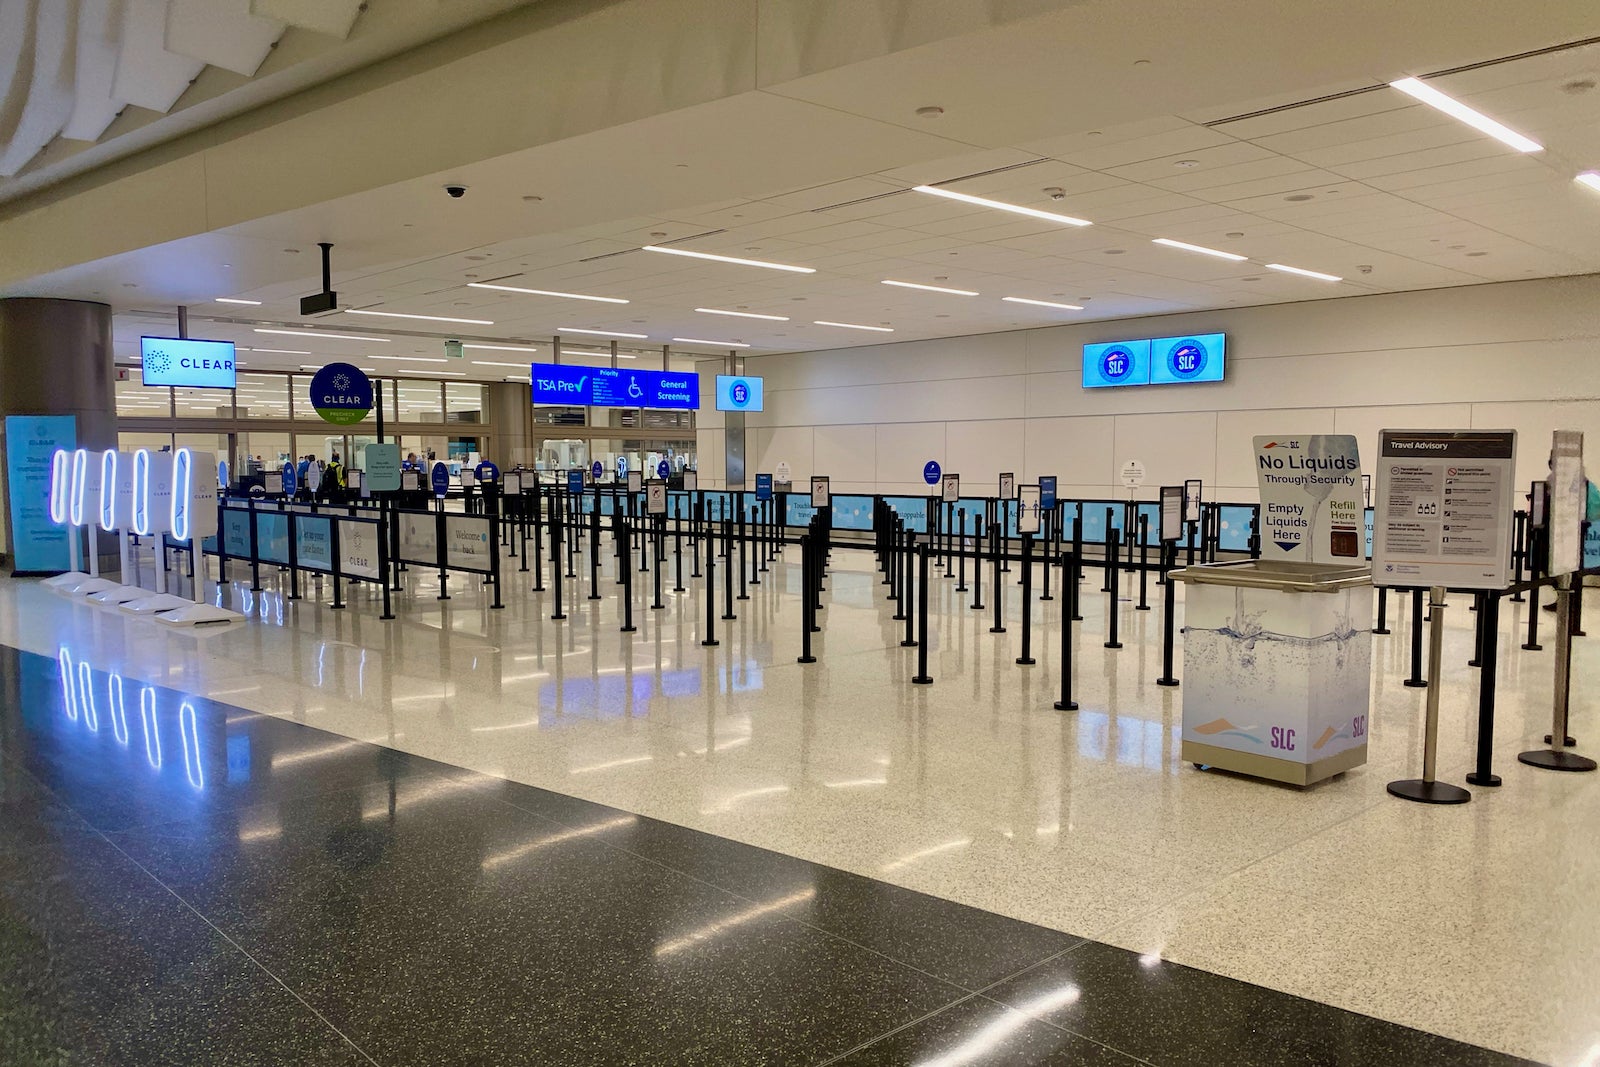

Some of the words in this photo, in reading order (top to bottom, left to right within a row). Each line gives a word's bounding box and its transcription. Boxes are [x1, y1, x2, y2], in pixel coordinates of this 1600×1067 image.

[180, 358, 232, 370] CLEAR
[1108, 360, 1123, 374] SLC
[1179, 355, 1194, 370] SLC
[537, 380, 556, 391] TSA
[558, 381, 574, 392] Pre
[660, 380, 687, 389] General
[324, 396, 360, 404] CLEAR
[658, 392, 690, 402] Screening
[1259, 455, 1284, 469] No
[1289, 455, 1357, 472] Liquids
[1265, 474, 1307, 485] Through
[1310, 475, 1355, 486] Security
[1268, 503, 1304, 515] Empty
[1330, 501, 1356, 510] Refill
[1331, 511, 1356, 520] Here
[1266, 516, 1307, 528] Liquids
[456, 530, 480, 541] Welcome
[1273, 530, 1300, 540] Here
[462, 546, 475, 554] back
[350, 556, 368, 567] CLEAR
[1353, 715, 1364, 738] SLC
[1271, 726, 1295, 750] SLC
